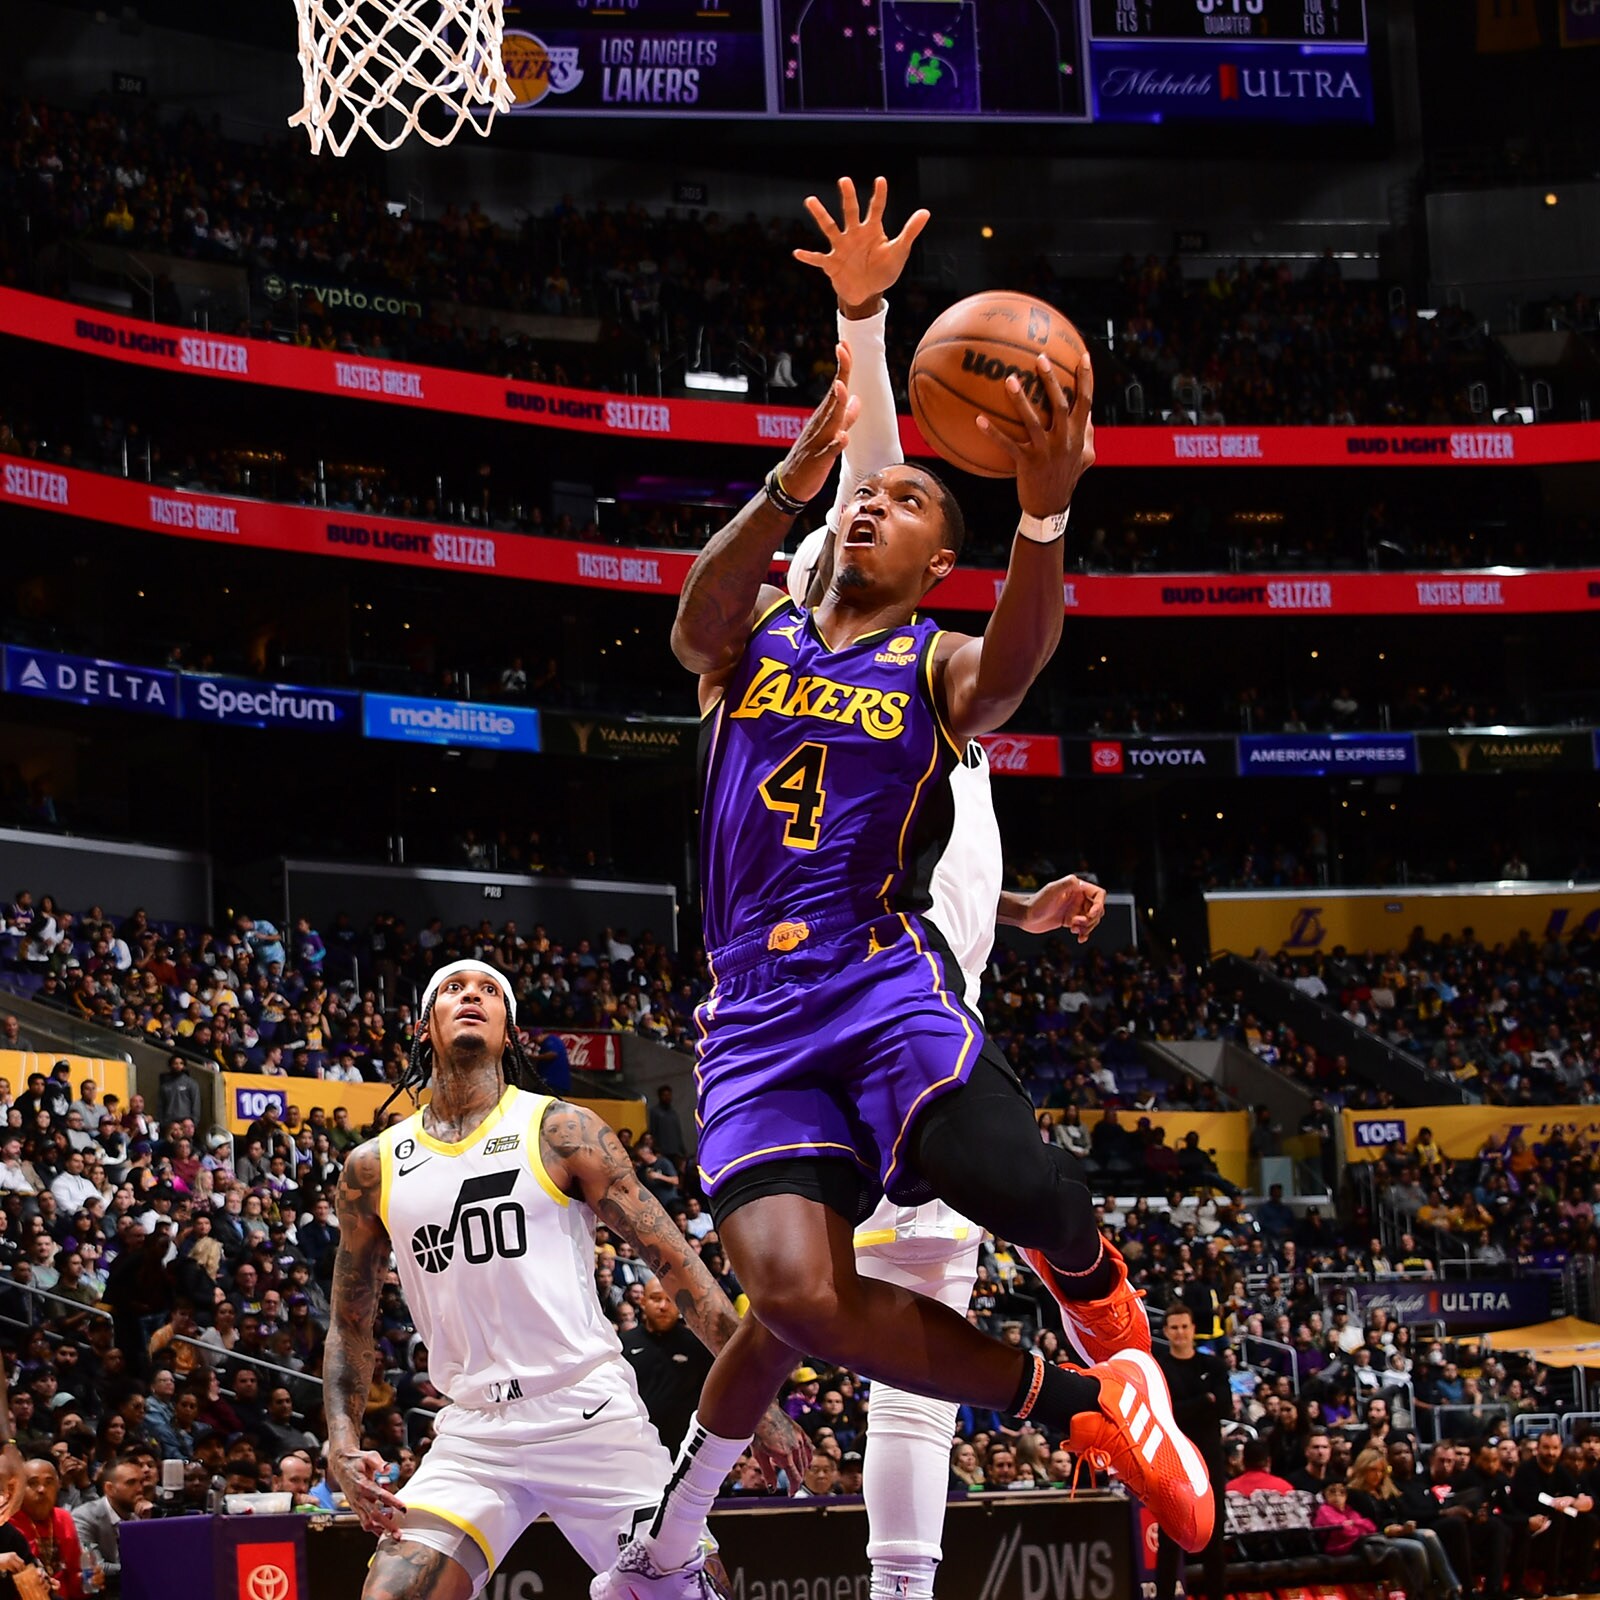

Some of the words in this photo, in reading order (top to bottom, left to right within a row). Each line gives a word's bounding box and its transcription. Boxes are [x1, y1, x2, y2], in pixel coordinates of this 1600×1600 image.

[1115, 11, 1139, 32] FLS
[1203, 16, 1252, 35] QUARTER
[1303, 14, 1325, 35] FLS
[600, 38, 634, 65] LOS
[638, 39, 718, 67] ANGELES
[602, 67, 700, 104] LAKERS
[1100, 66, 1213, 97] Michelob
[1241, 69, 1362, 98] ULTRA
[76, 318, 115, 346] BUD
[118, 331, 178, 357] LIGHT
[180, 337, 248, 374] SELTZER
[335, 362, 380, 391] TASTES
[382, 369, 424, 398] GREAT.
[506, 391, 547, 413] BUD
[549, 398, 605, 421] LIGHT
[606, 401, 670, 432] SELTZER
[756, 414, 801, 438] TASTES
[1173, 435, 1218, 457] TASTES
[1219, 435, 1263, 458] GREAT.
[1347, 437, 1388, 454] BUD
[1392, 437, 1449, 454] LIGHT
[1450, 433, 1514, 459] SELTZER
[5, 464, 68, 505] SELTZER
[150, 496, 194, 527] TASTES
[196, 503, 240, 534] GREAT.
[327, 524, 370, 546] BUD
[373, 531, 431, 554] LIGHT
[433, 534, 496, 567] SELTZER
[577, 553, 619, 580] TASTES
[620, 558, 662, 585] GREAT.
[1161, 586, 1205, 604] BUD
[1208, 587, 1266, 604] LIGHT
[1267, 582, 1332, 608] SELTZER
[1416, 582, 1460, 606] TASTES
[1461, 582, 1505, 606] GREAT.
[875, 652, 917, 666] bibigo
[56, 664, 166, 706] DELTA
[730, 657, 911, 741] LAKERS
[198, 682, 336, 723] Spectrum
[390, 706, 515, 735] mobilitie
[1128, 749, 1207, 766] TOYOTA
[1250, 749, 1332, 764] AMERICAN
[1335, 748, 1407, 763] EXPRESS
[757, 741, 829, 849] 4
[240, 1091, 283, 1117] 103
[1358, 1122, 1402, 1144] 105
[460, 1202, 527, 1264] 00
[1441, 1292, 1511, 1311] ULTRA
[1020, 1540, 1114, 1600] DWS
